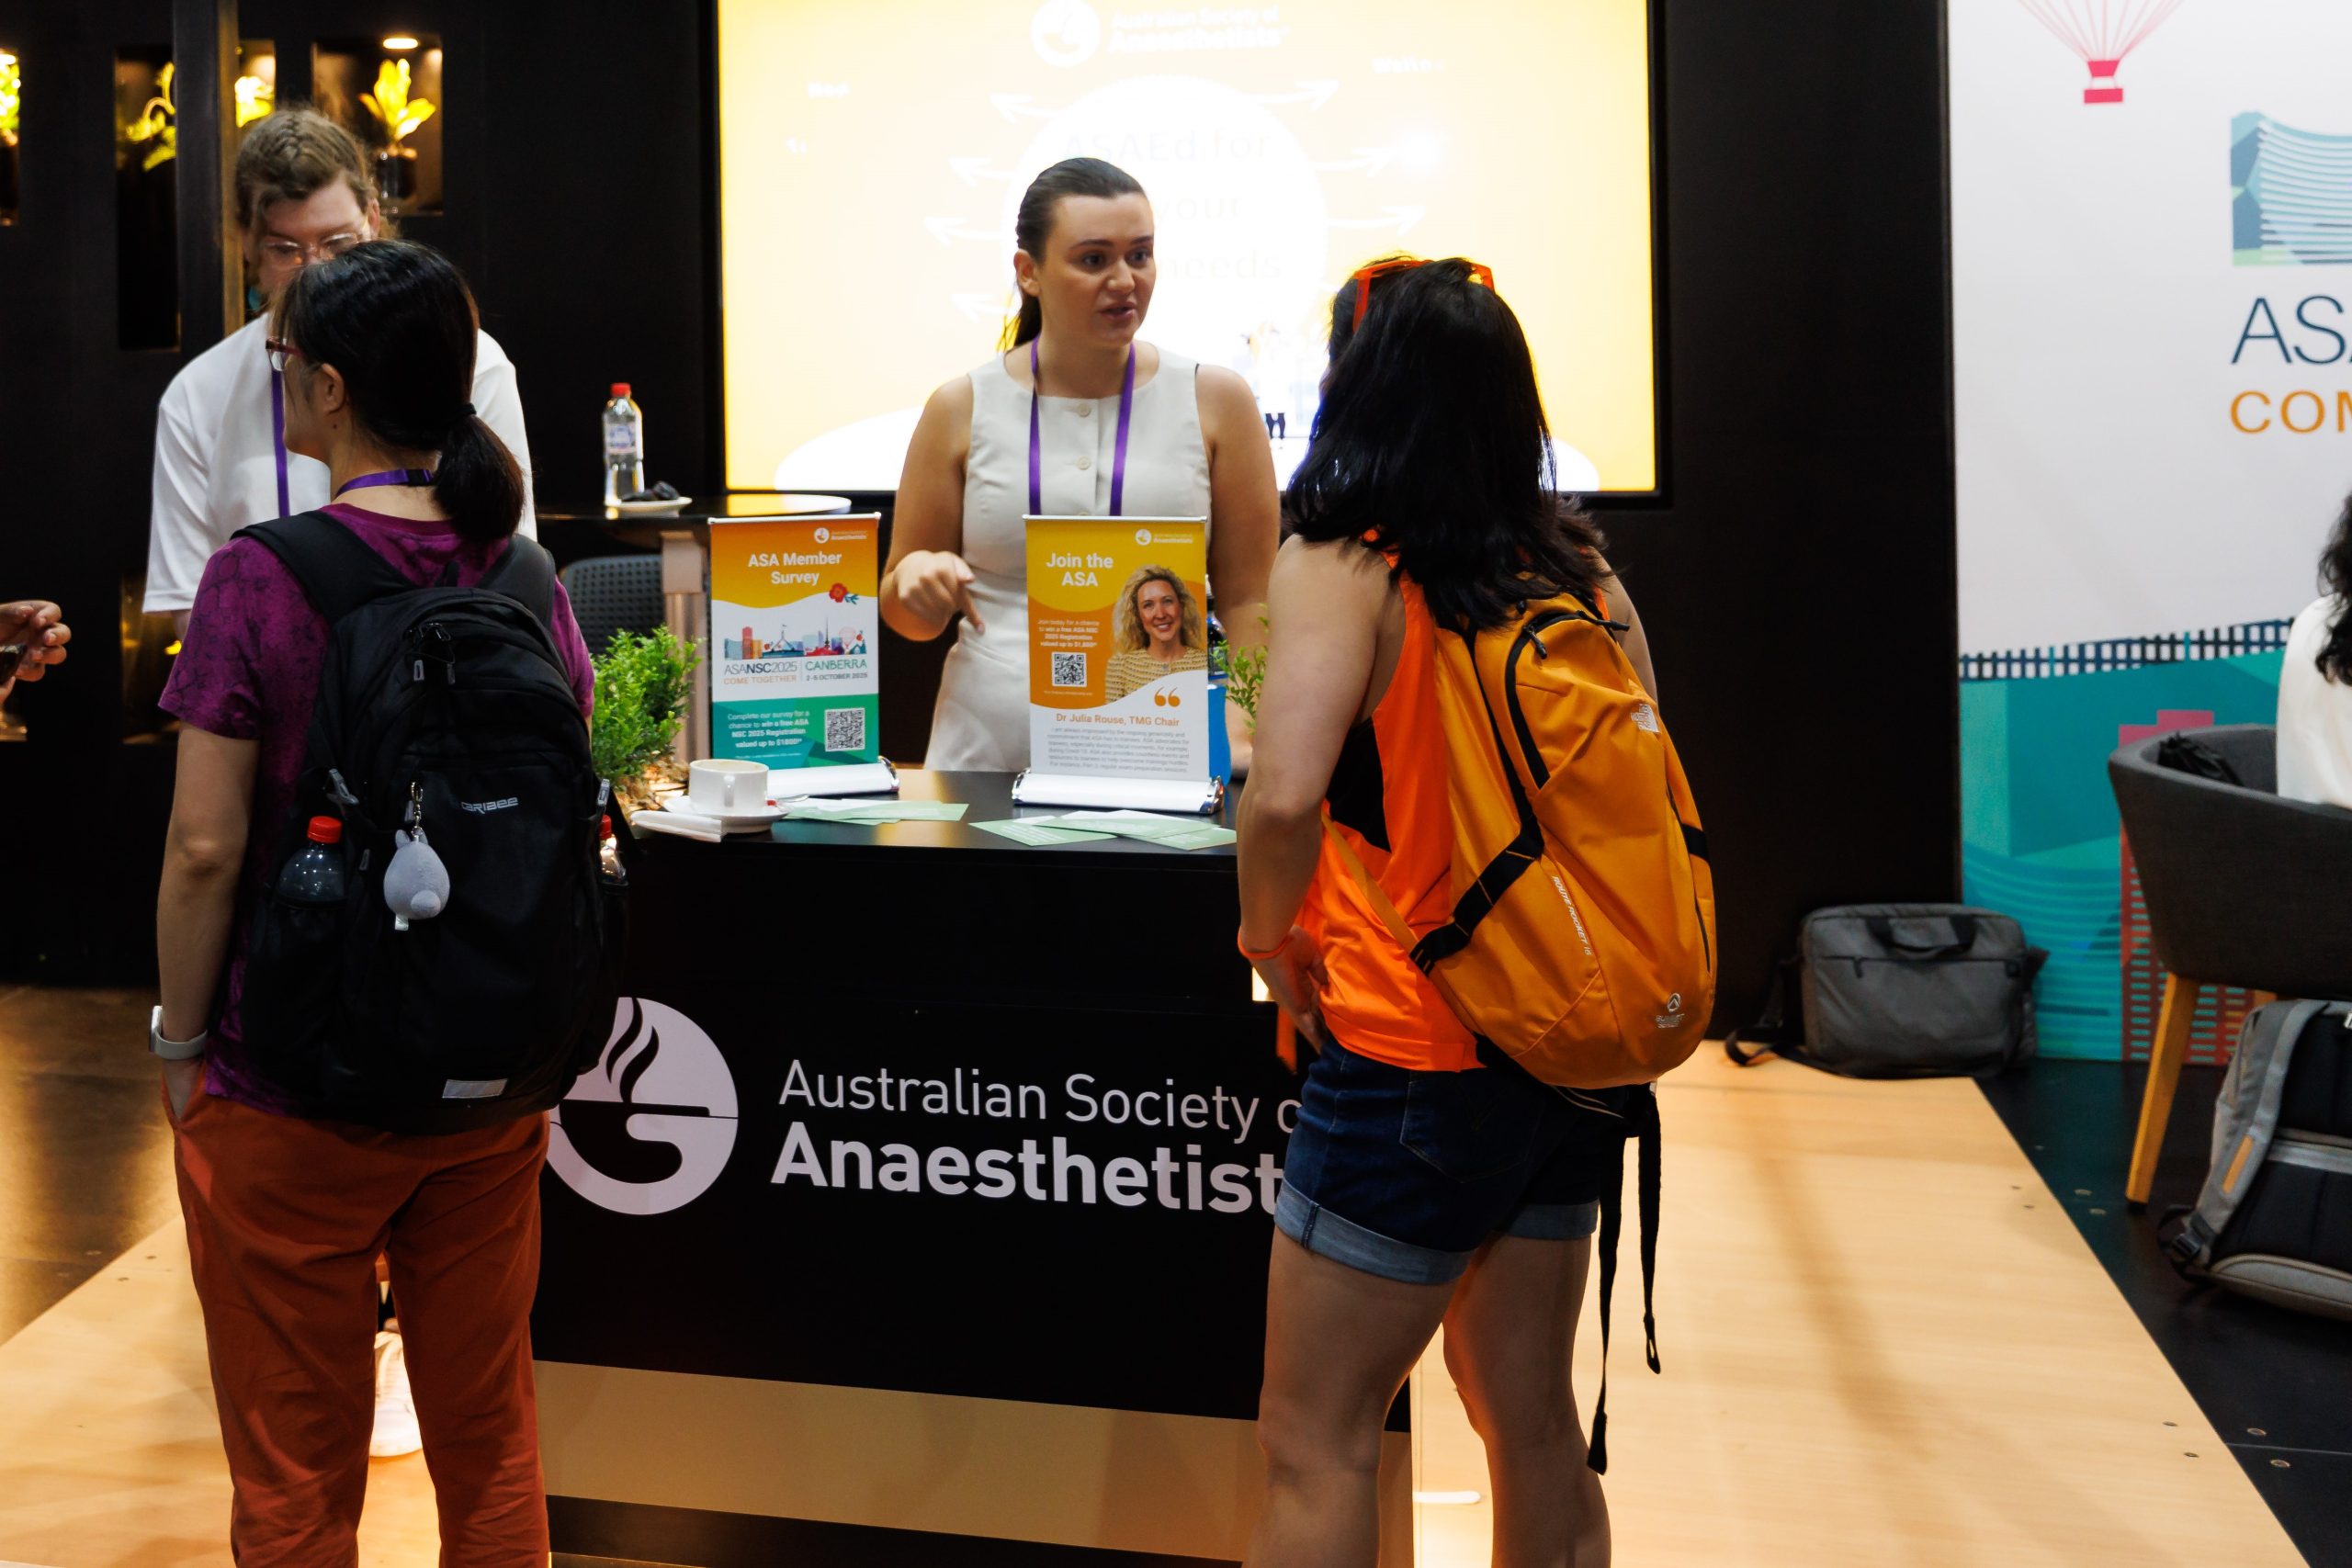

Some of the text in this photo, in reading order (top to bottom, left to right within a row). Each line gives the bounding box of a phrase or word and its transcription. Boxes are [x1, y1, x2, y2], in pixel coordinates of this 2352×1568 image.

[2231, 294, 2352, 366] AS
[748, 551, 842, 568] ASA Member
[1046, 553, 1114, 569] Join the
[771, 571, 820, 586] Survey
[1061, 572, 1099, 587] ASA
[724, 659, 867, 675] ASANSC2025 CANBERRA
[723, 674, 797, 685] COME TOGETHER
[1057, 713, 1180, 727] Dr Julia Rouse, TMG Chair
[1551, 875, 1572, 906] ROUTE
[1568, 906, 1589, 944] ROCKET
[778, 1058, 1047, 1120] Australian
[1065, 1073, 1260, 1145] Society
[770, 1121, 1286, 1215] Anaesthetist
